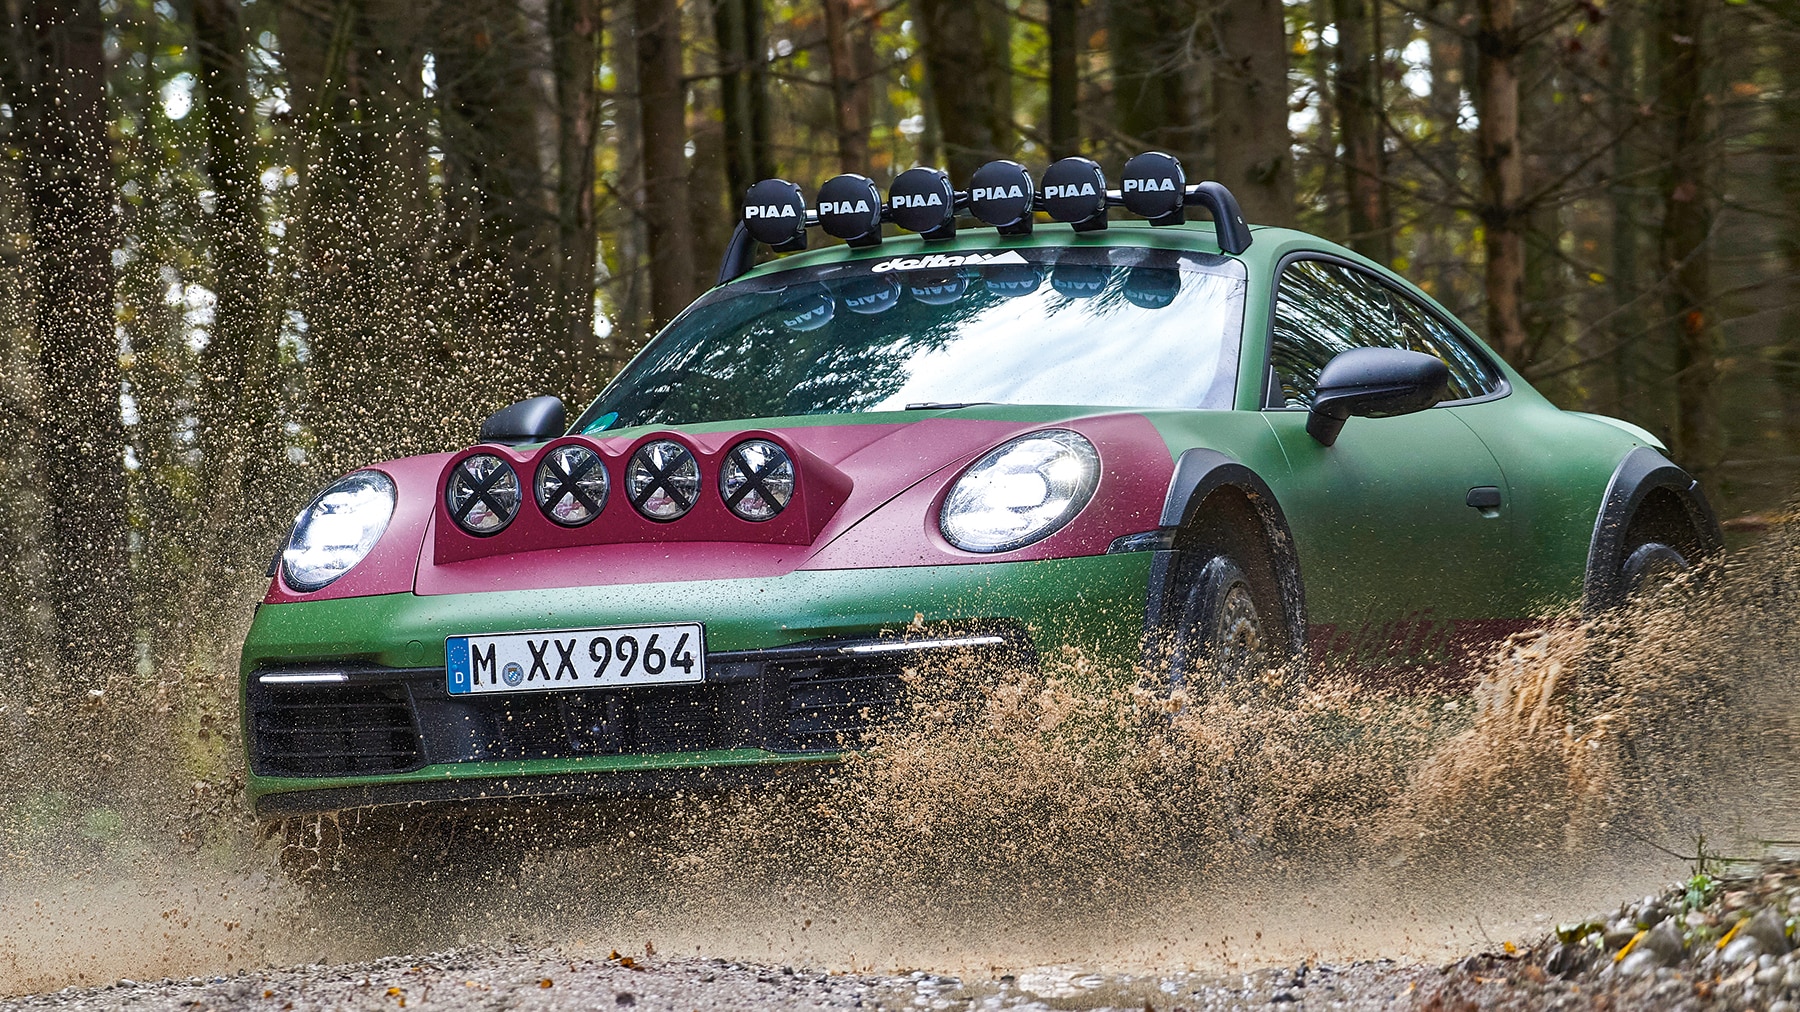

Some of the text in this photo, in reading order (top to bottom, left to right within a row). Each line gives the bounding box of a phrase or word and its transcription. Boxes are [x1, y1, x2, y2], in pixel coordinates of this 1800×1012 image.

[972, 185, 1023, 201] PIAA
[1044, 182, 1095, 199] PIAA
[1123, 178, 1175, 193] PIAA
[819, 200, 870, 215] PIAA
[892, 193, 942, 208] PIAA
[745, 204, 796, 218] PIAA
[471, 643, 497, 685] M
[526, 638, 579, 681] XX
[588, 632, 695, 679] 9964
[455, 672, 464, 684] D
